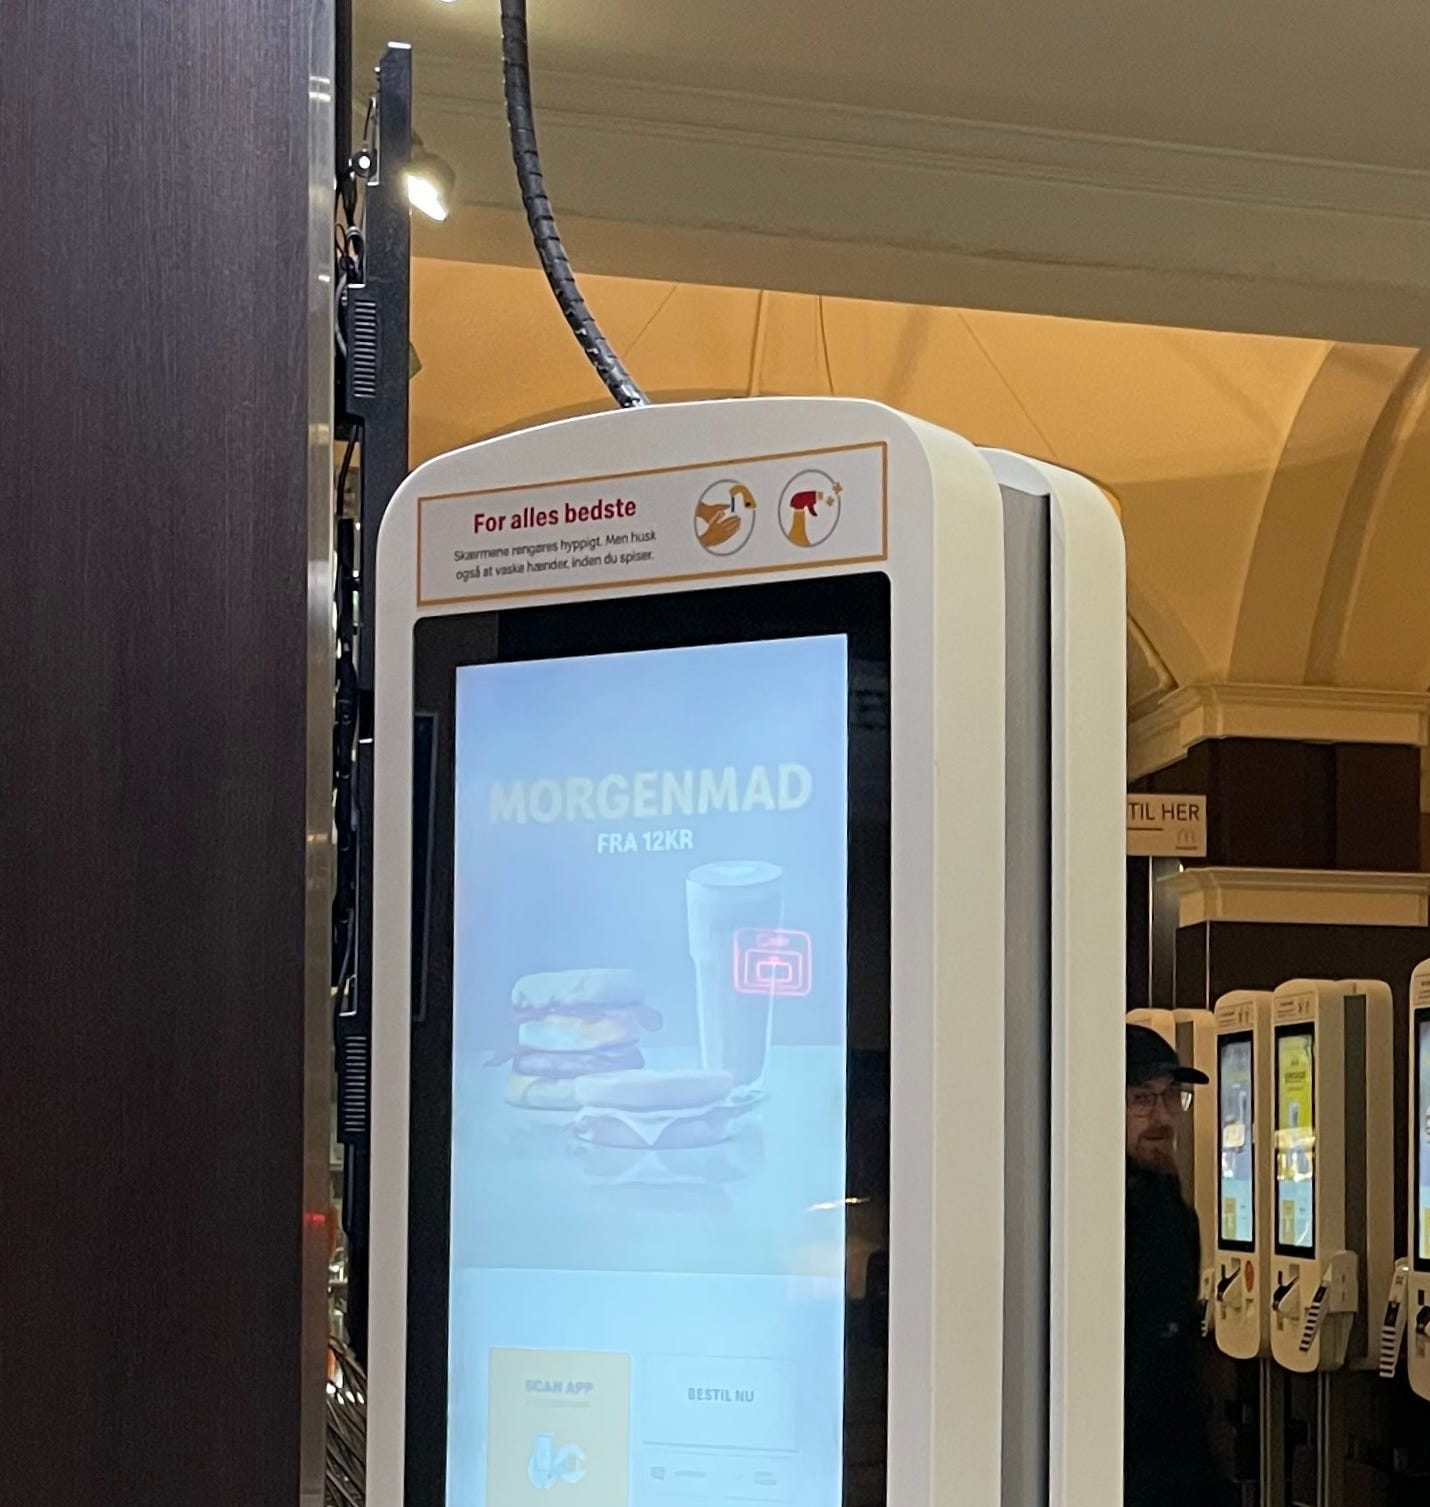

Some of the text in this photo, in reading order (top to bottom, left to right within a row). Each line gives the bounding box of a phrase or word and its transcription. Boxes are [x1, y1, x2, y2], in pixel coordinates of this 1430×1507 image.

[473, 498, 636, 534] For alles bedste
[454, 547, 510, 562] Skærmene
[560, 536, 602, 555] hyppigt.
[605, 534, 629, 546] Men
[631, 529, 656, 542] husk
[456, 565, 480, 583] også
[482, 566, 493, 577] at
[494, 561, 525, 576] vaske
[572, 554, 601, 568] inden
[604, 552, 618, 565] du
[620, 550, 655, 566] spiser.
[489, 763, 813, 825] MORGENMAD
[1161, 803, 1200, 822] HER
[596, 829, 694, 854] FRA 12KR
[525, 1379, 594, 1396] SCAN APP
[688, 1387, 755, 1403] BESTIL NU
